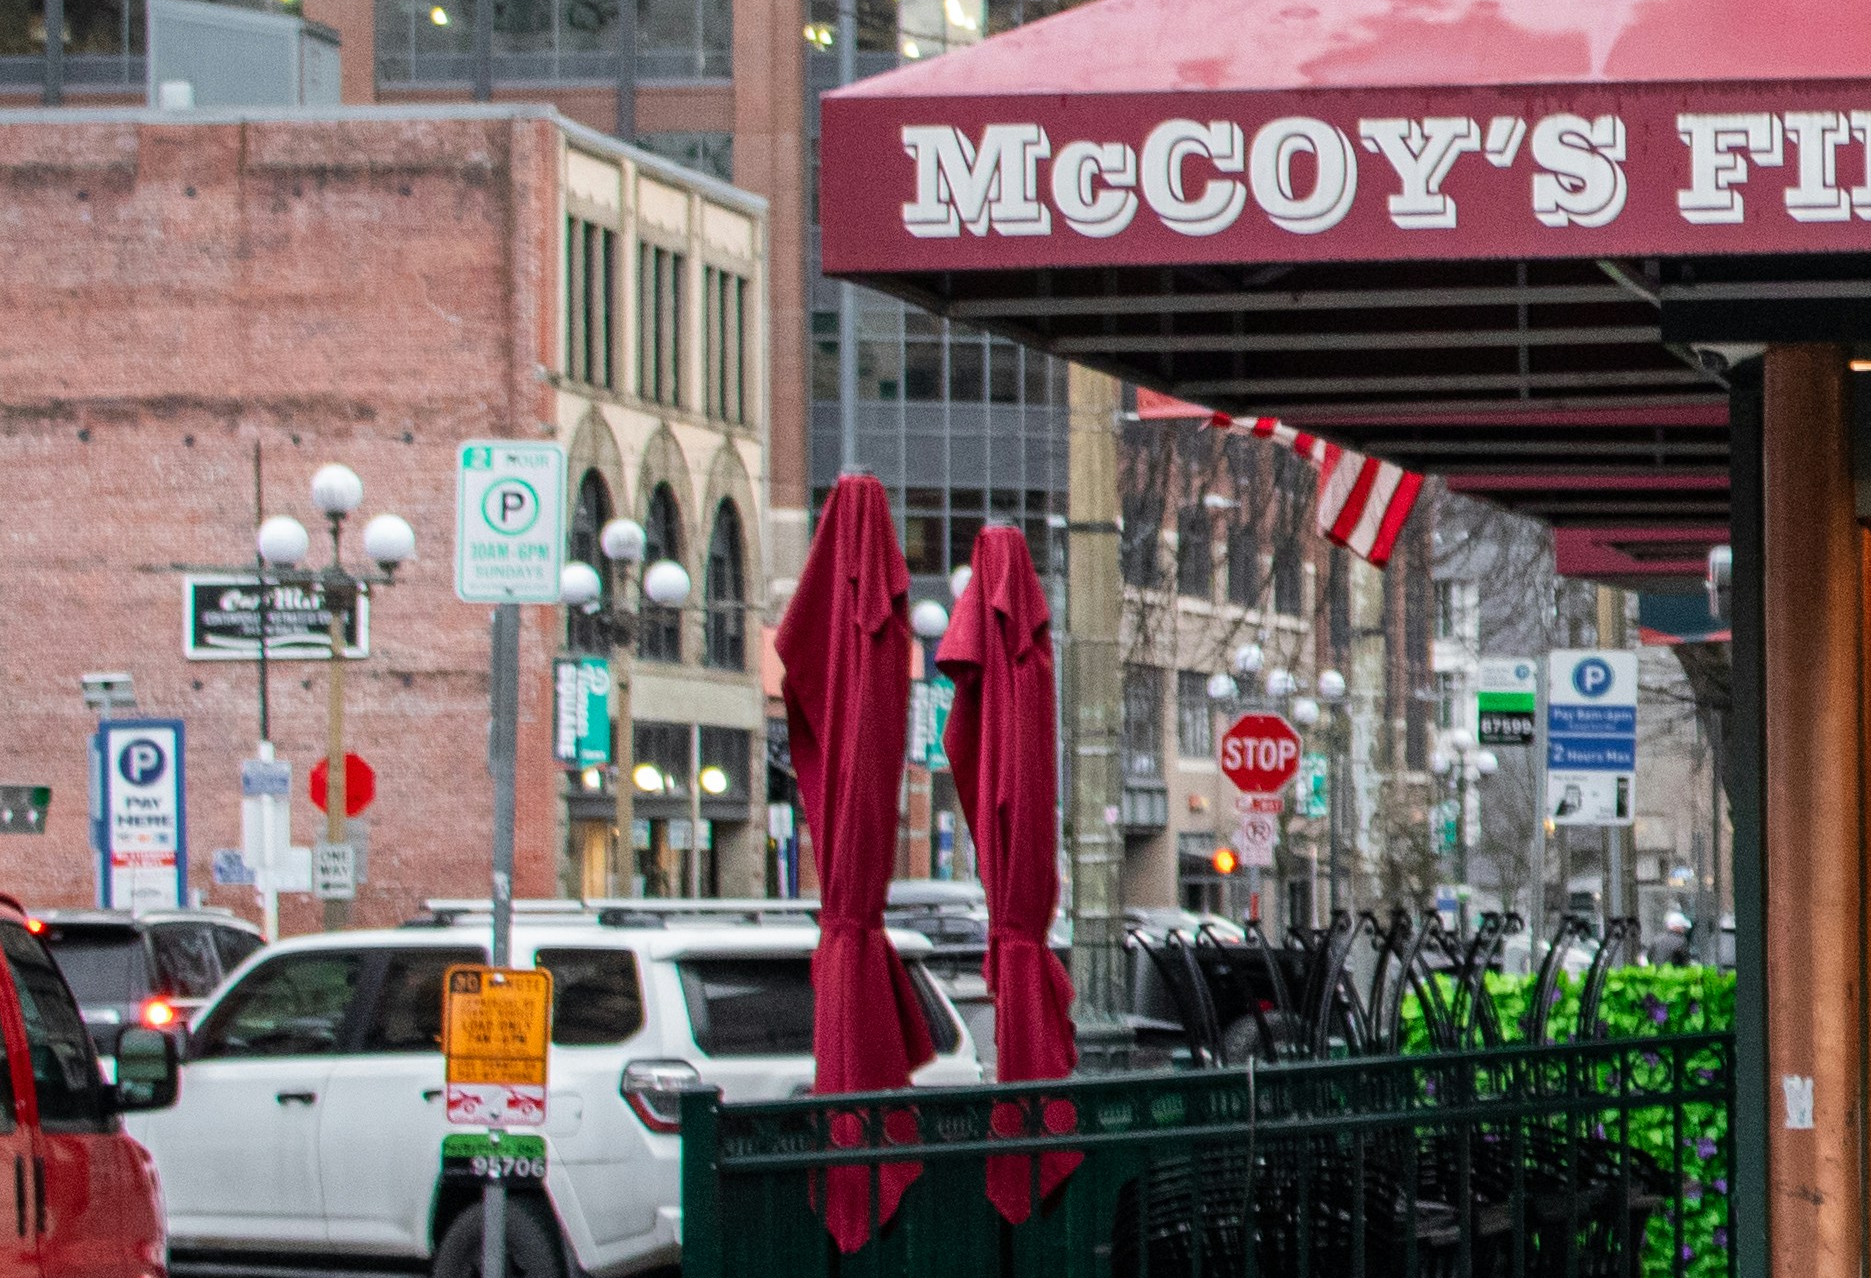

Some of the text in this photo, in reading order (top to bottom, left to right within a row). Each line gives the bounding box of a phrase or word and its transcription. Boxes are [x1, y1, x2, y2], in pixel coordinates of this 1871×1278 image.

[901, 111, 1627, 237] McCOY'S
[501, 491, 526, 523] P
[1584, 665, 1606, 692] P
[131, 745, 159, 781] P
[1224, 737, 1297, 772] STOP
[1606, 749, 1632, 762] Max
[124, 797, 160, 809] PAY
[117, 814, 169, 826] HERE
